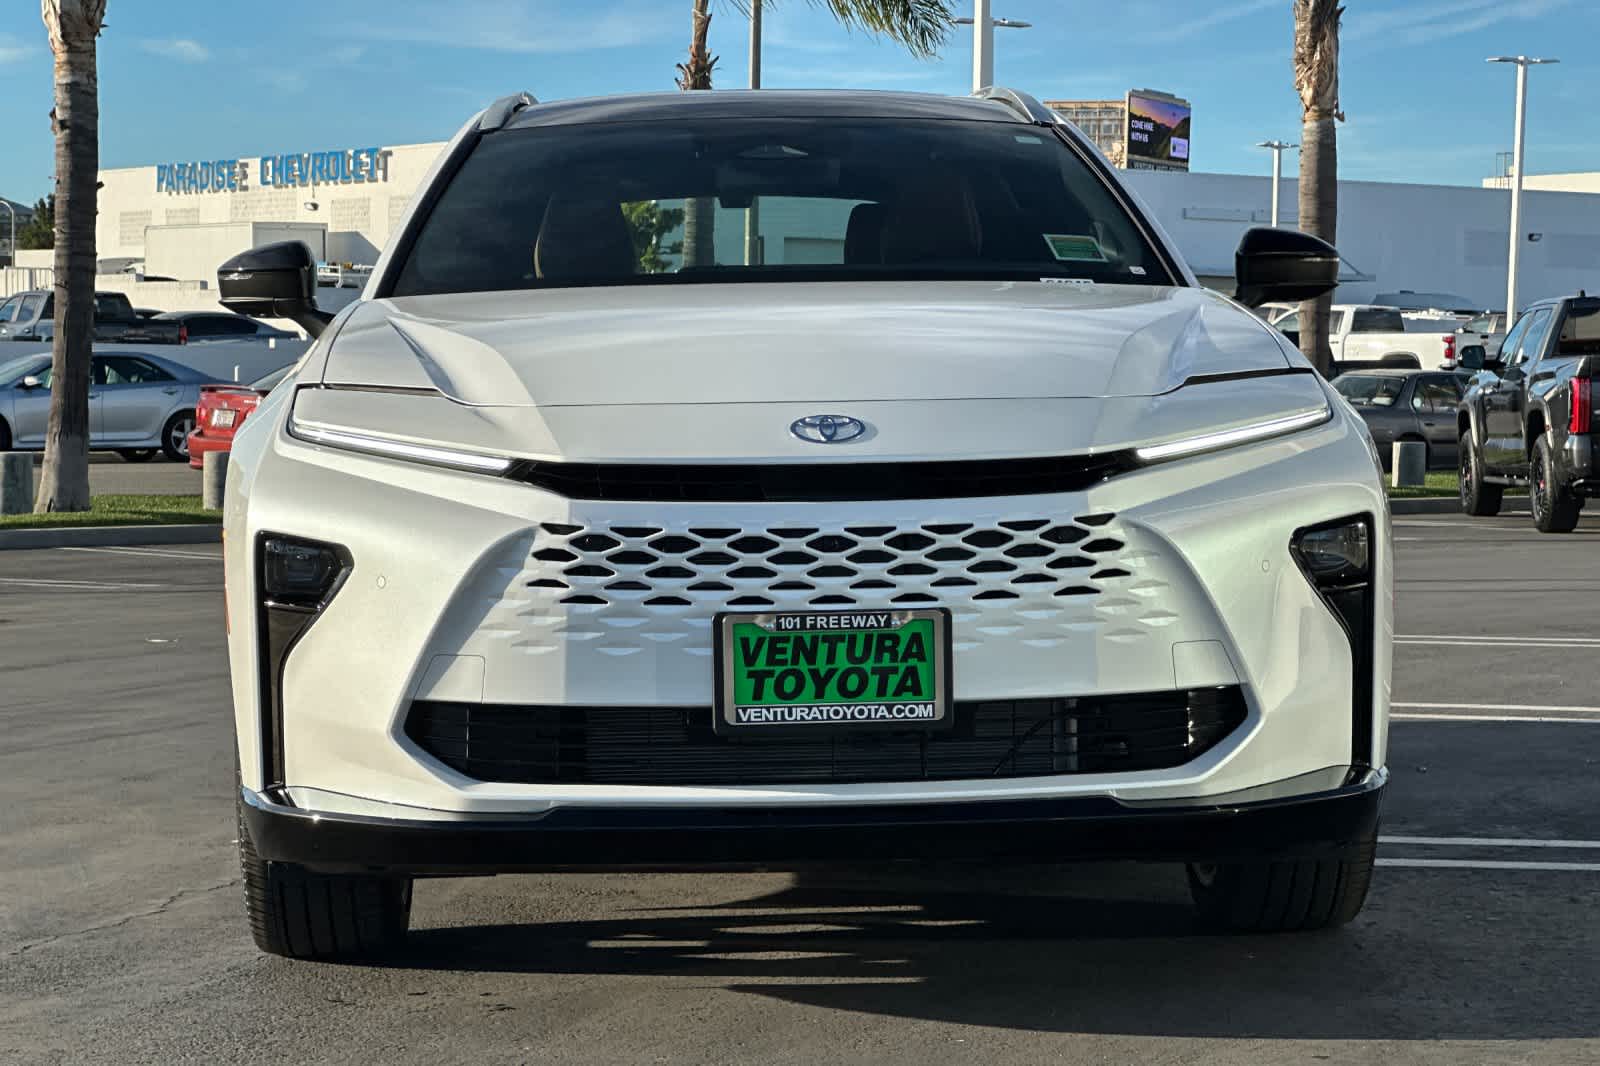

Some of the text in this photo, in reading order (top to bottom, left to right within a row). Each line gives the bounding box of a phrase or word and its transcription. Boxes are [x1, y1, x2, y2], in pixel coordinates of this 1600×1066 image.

[156, 148, 382, 194] PARADISE CHEVROLET
[778, 615, 888, 630] 101 FREEWAY
[740, 632, 926, 667] VENTURA
[746, 666, 923, 701] TOYOTA
[738, 704, 933, 722] VENTURATOYOTA.COM
